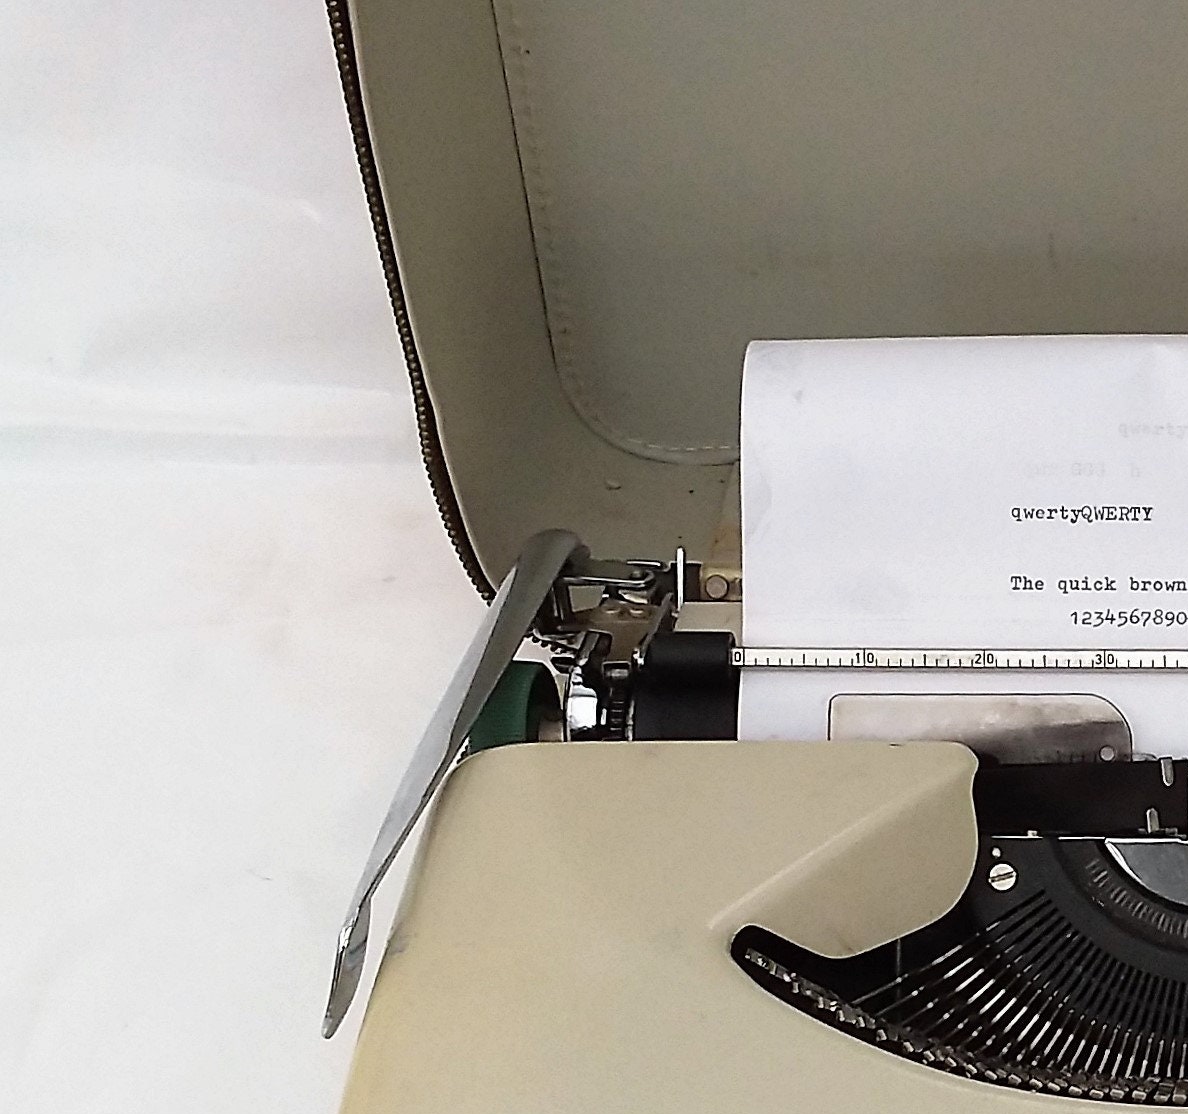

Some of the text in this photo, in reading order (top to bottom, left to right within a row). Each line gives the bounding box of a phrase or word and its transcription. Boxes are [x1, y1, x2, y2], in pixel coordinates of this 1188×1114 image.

[1011, 505, 1154, 524] qwertyQWERTY
[1011, 576, 1044, 590] The
[1058, 576, 1116, 594] quick
[1130, 577, 1187, 591] brown
[734, 651, 742, 663] 0
[855, 652, 875, 664] 10
[974, 653, 994, 665] 20
[1095, 653, 1115, 666] 30
